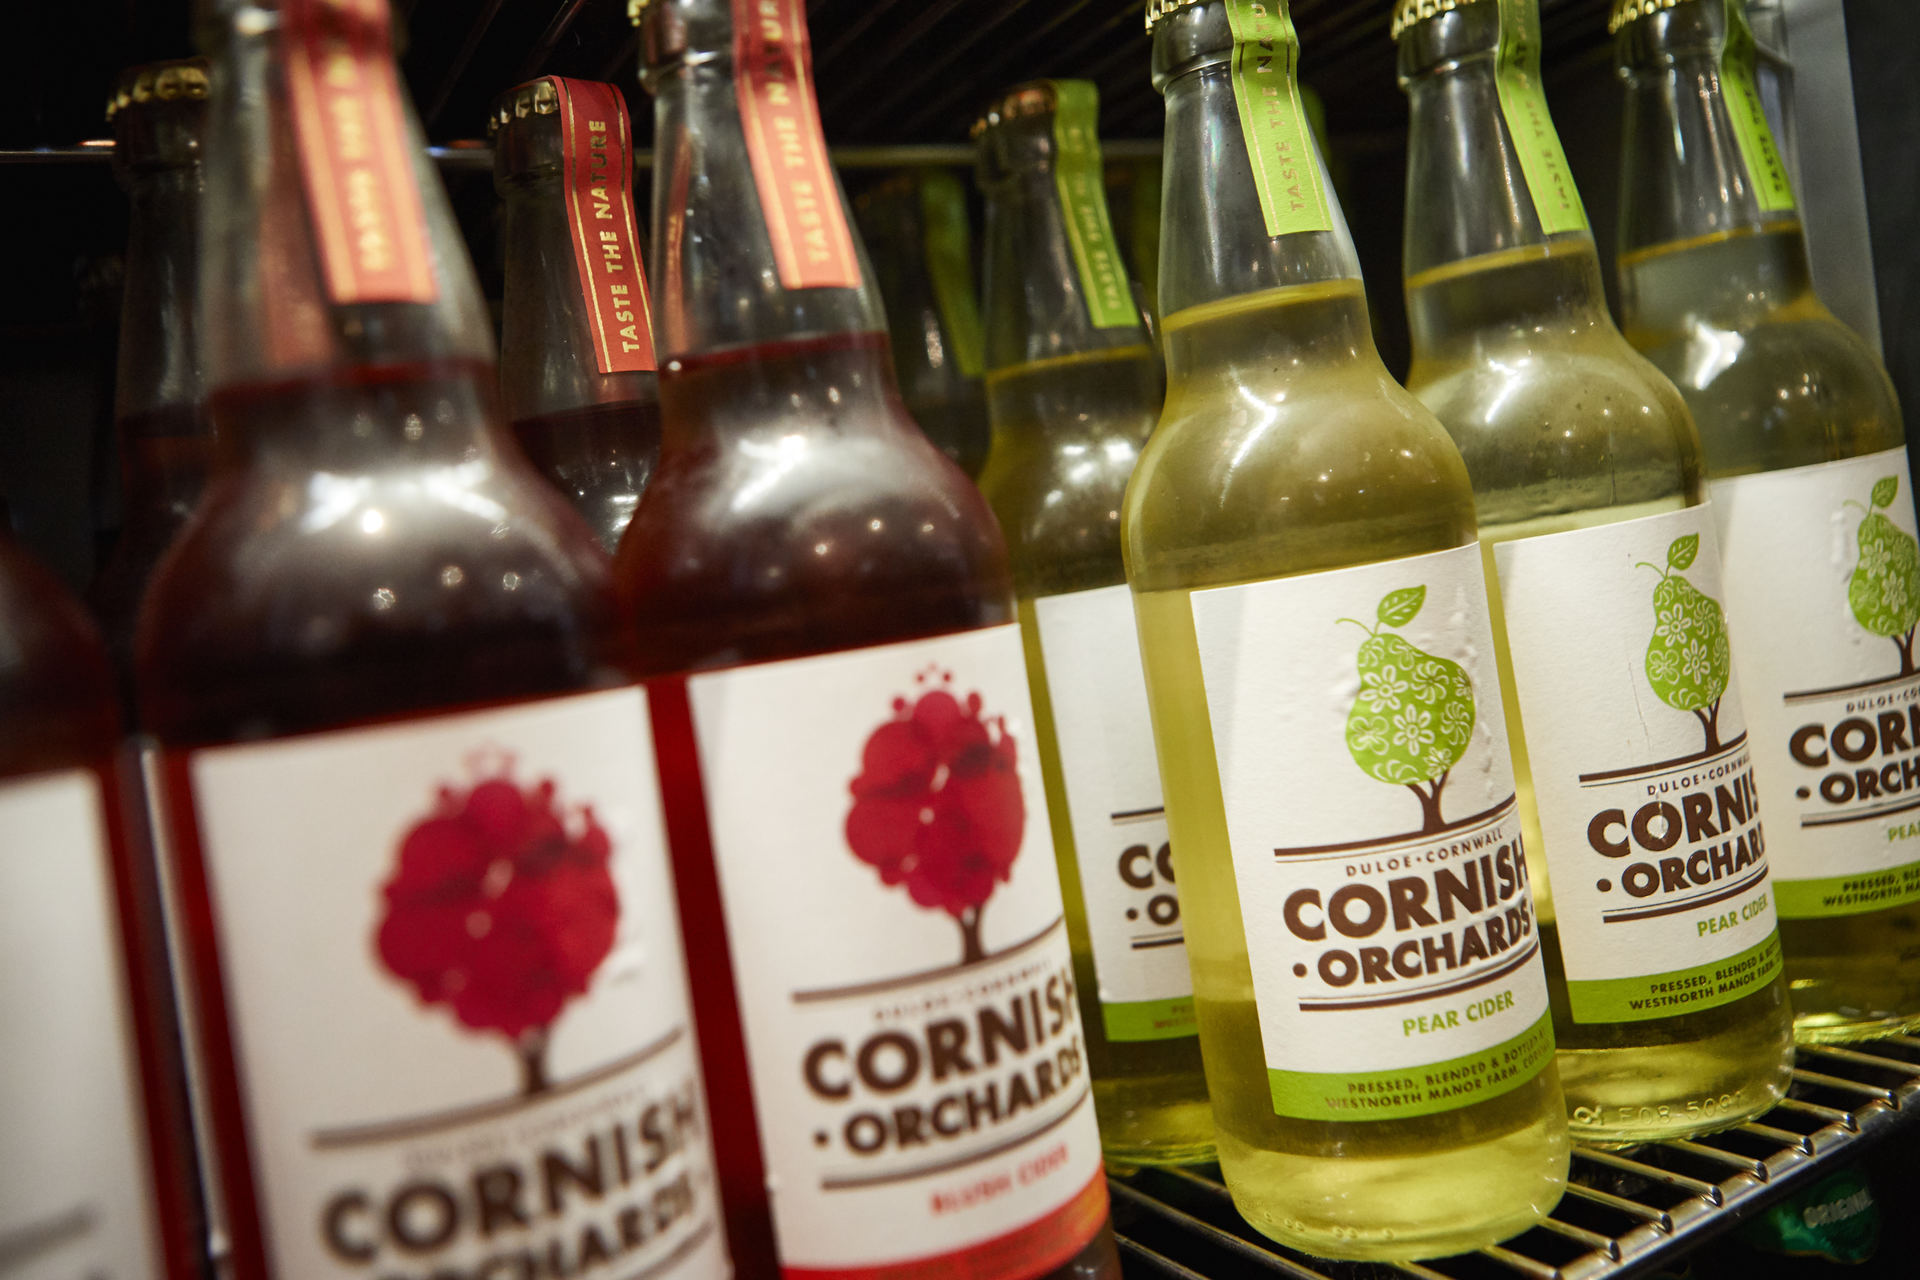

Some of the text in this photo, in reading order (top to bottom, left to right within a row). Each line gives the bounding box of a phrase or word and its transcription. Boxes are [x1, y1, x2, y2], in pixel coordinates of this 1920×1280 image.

[1262, 87, 1286, 130] THE
[1276, 141, 1305, 211] TASTE
[588, 119, 640, 353] TASTE THE NATURE
[1903, 686, 1920, 702] CO
[1345, 827, 1503, 877] DULOE CORNWALL
[1888, 820, 1920, 843] PEA
[1282, 832, 1529, 942] CORNISH
[1696, 892, 1768, 937] PEAR CIDER
[1317, 897, 1531, 988] ORCHARDS
[1628, 987, 1714, 1010] WESTNORTH
[1718, 973, 1755, 994] MANOR
[1715, 957, 1757, 981] BLENDED
[803, 967, 1074, 1102] CORNISH
[1402, 990, 1515, 1038] PEAR CIDER
[1324, 1091, 1422, 1109] WESTNORTH
[1428, 1081, 1482, 1100] MANOR
[1424, 1061, 1486, 1086] BLENDED
